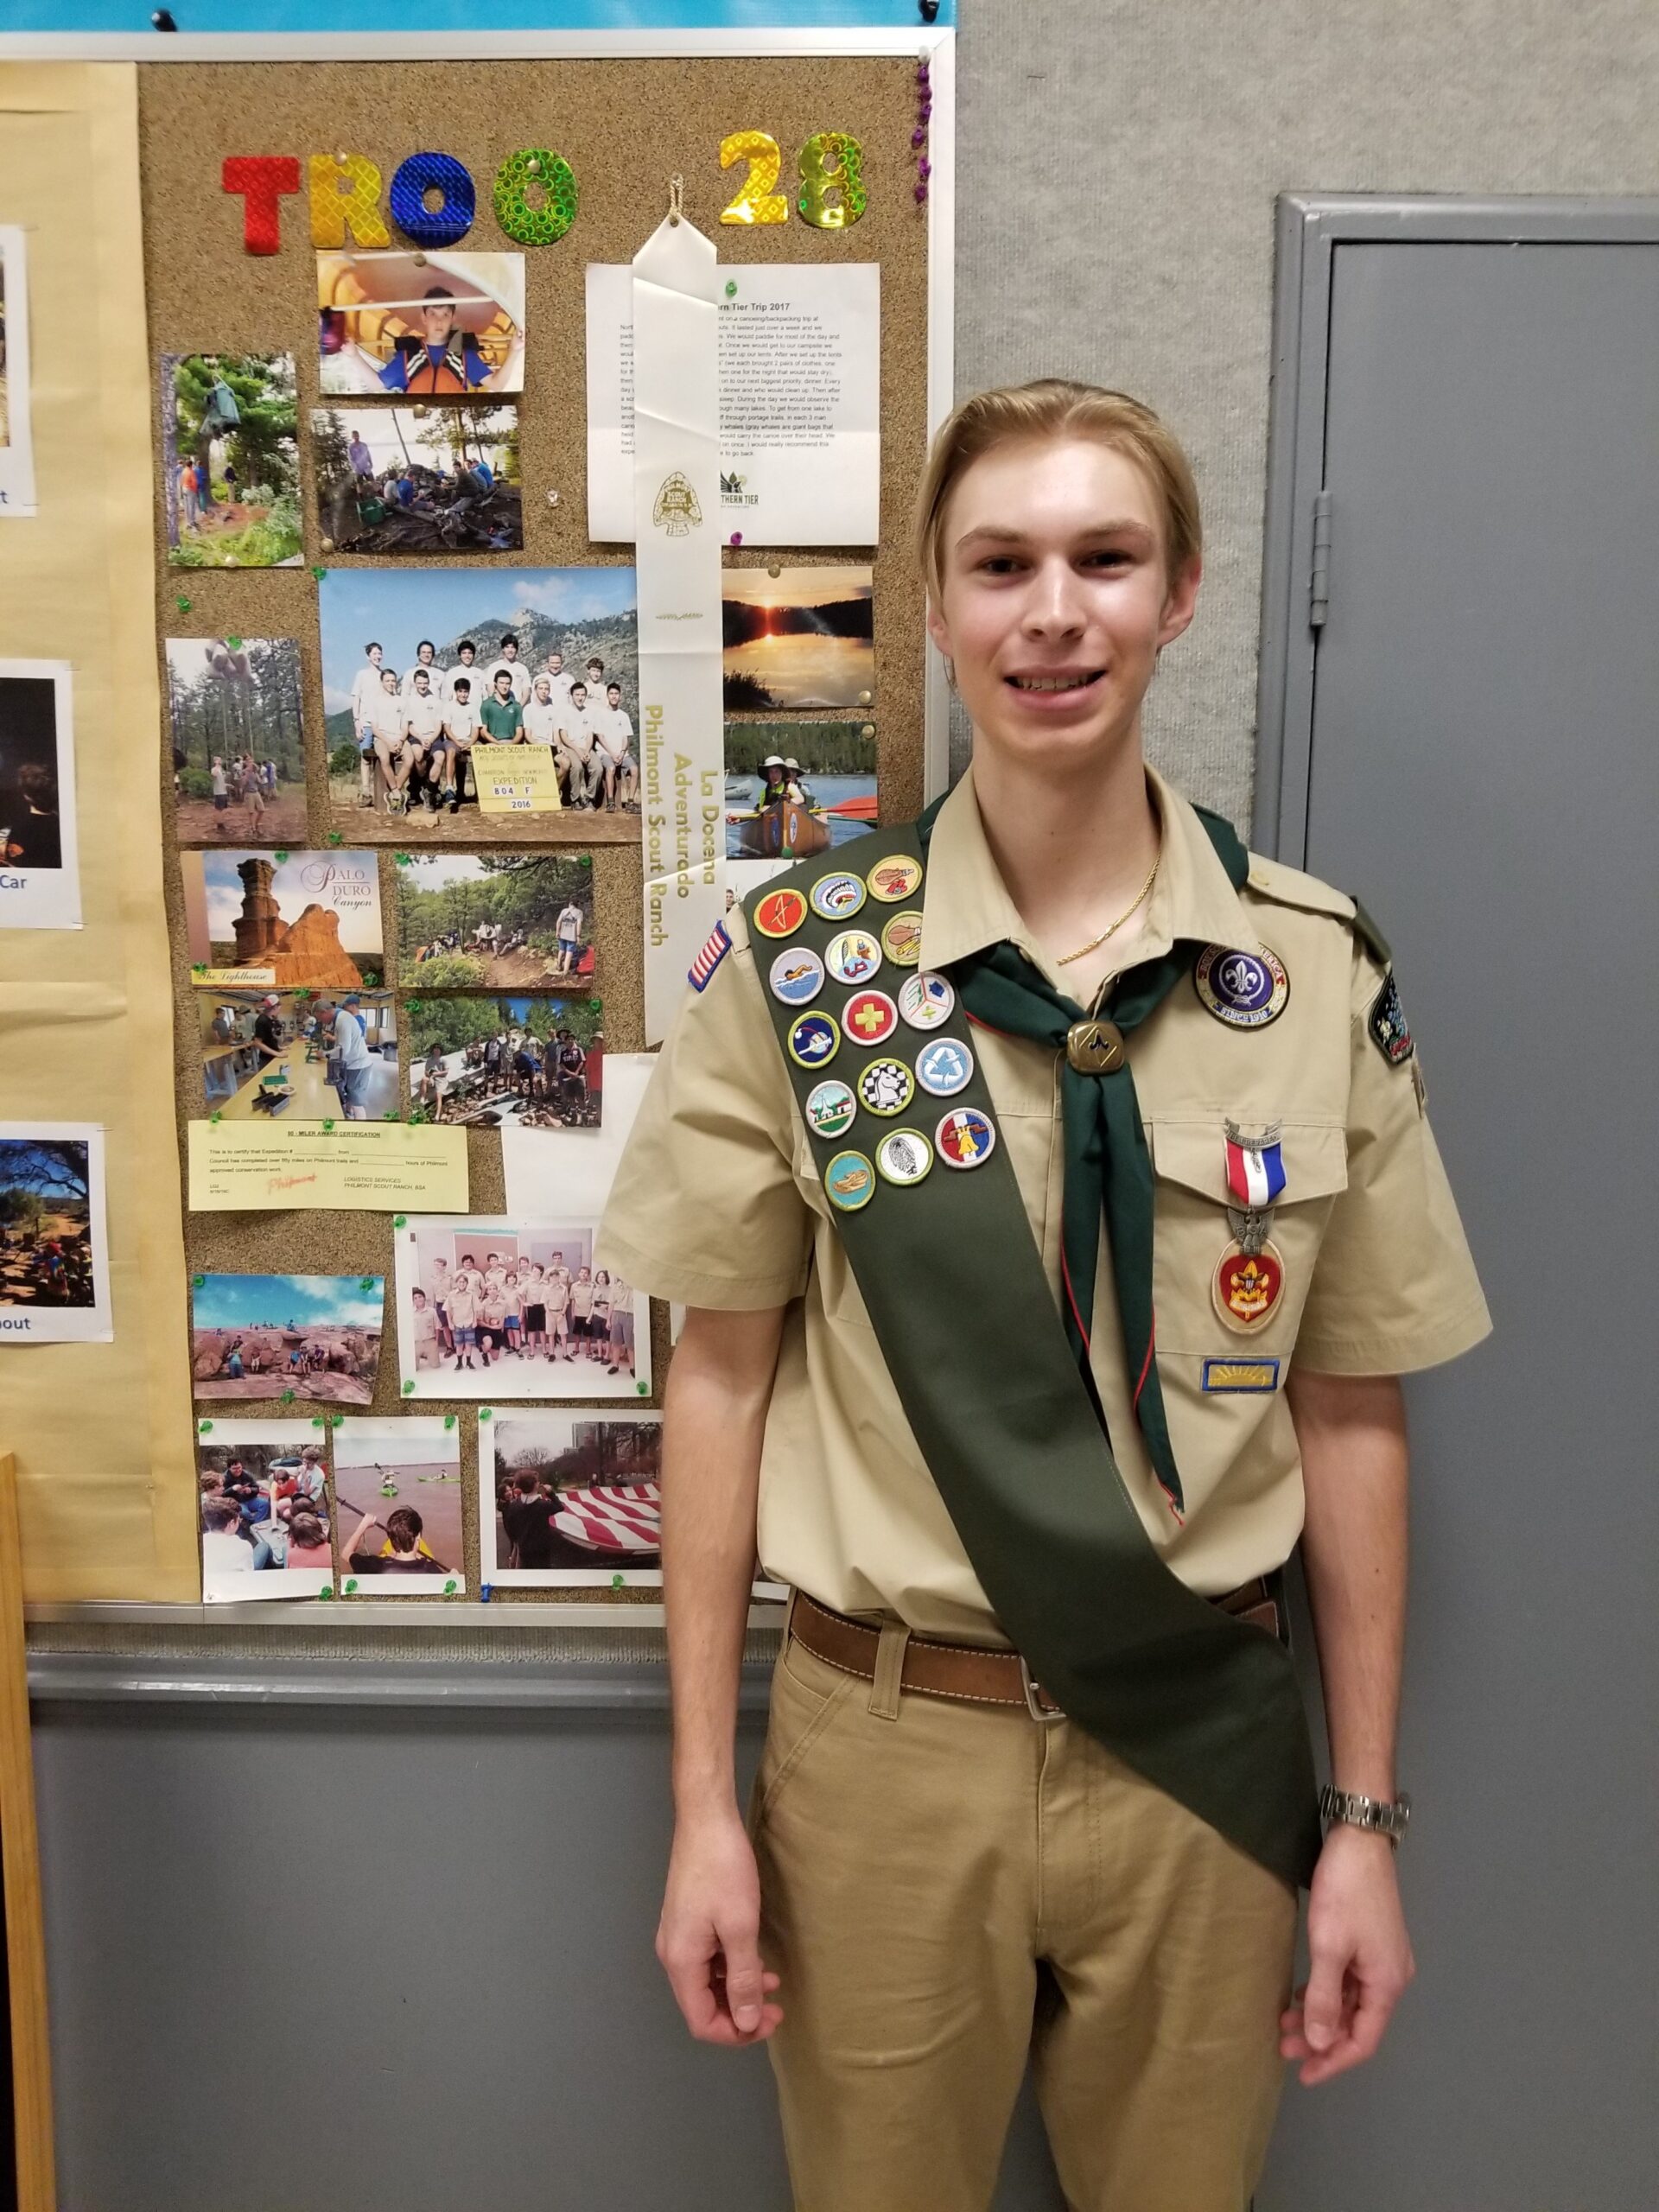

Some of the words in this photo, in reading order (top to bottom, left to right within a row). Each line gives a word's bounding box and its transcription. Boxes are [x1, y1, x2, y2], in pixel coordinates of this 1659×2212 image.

[719, 130, 867, 230] 28
[719, 302, 729, 311] rn
[732, 302, 748, 311] Tier
[751, 302, 767, 313] Trip
[770, 302, 790, 311] 2017
[721, 494, 743, 504] THERN
[745, 494, 759, 505] TIER
[645, 705, 664, 804] Philmont
[700, 771, 718, 796] La
[512, 800, 531, 809] 2016
[674, 752, 695, 899] Adventurado
[648, 814, 666, 873] Scout
[702, 805, 720, 884] Docena
[0, 874, 27, 888] Car
[301, 861, 365, 893] PALO
[333, 885, 372, 896] DURO
[332, 895, 372, 910] Canyon
[650, 883, 669, 947] Ranch
[221, 971, 266, 982] Lighthouse
[1220, 1007, 1249, 1022] SINCE
[1249, 1010, 1268, 1023] 1910
[0, 1318, 31, 1330] out
